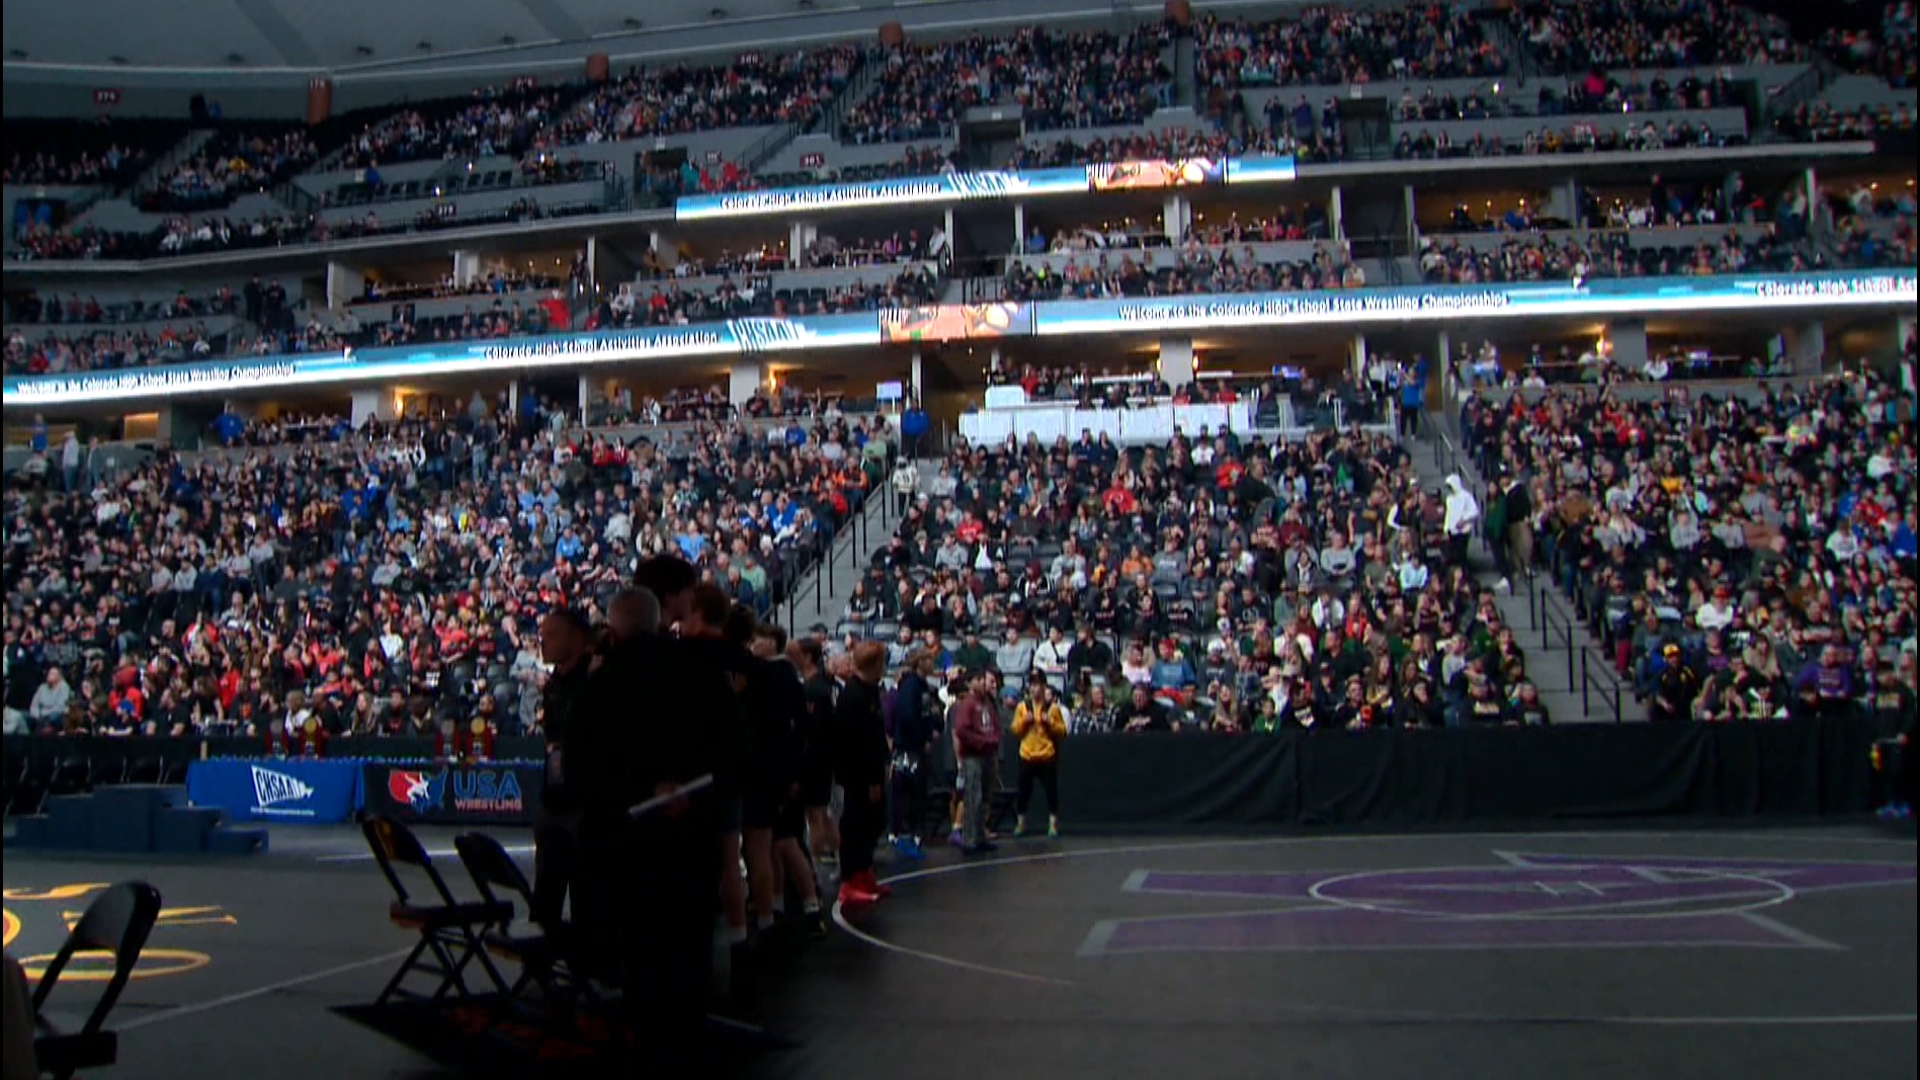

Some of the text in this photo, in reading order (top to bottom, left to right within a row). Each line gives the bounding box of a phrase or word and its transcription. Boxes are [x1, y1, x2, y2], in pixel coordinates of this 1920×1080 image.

[794, 189, 828, 206] School
[829, 184, 877, 203] Activities
[879, 181, 941, 199] Association
[1756, 278, 1816, 296] Colorado
[1817, 277, 1849, 295] High
[1851, 275, 1895, 294] School
[1119, 289, 1509, 321] Welcome to the Colorado High School State Wrestling Championships
[484, 330, 719, 360] Colorado High School Activities Association
[17, 381, 55, 396] Welcome
[67, 379, 82, 393] the
[83, 376, 118, 391] Colorado
[119, 373, 138, 389] High
[139, 371, 167, 388] School
[168, 369, 189, 385] State
[189, 366, 230, 384] Wrestling
[231, 361, 295, 380] Championships
[255, 769, 296, 803] CHSAA
[453, 770, 523, 799] USA
[454, 799, 523, 812] WRESTLING
